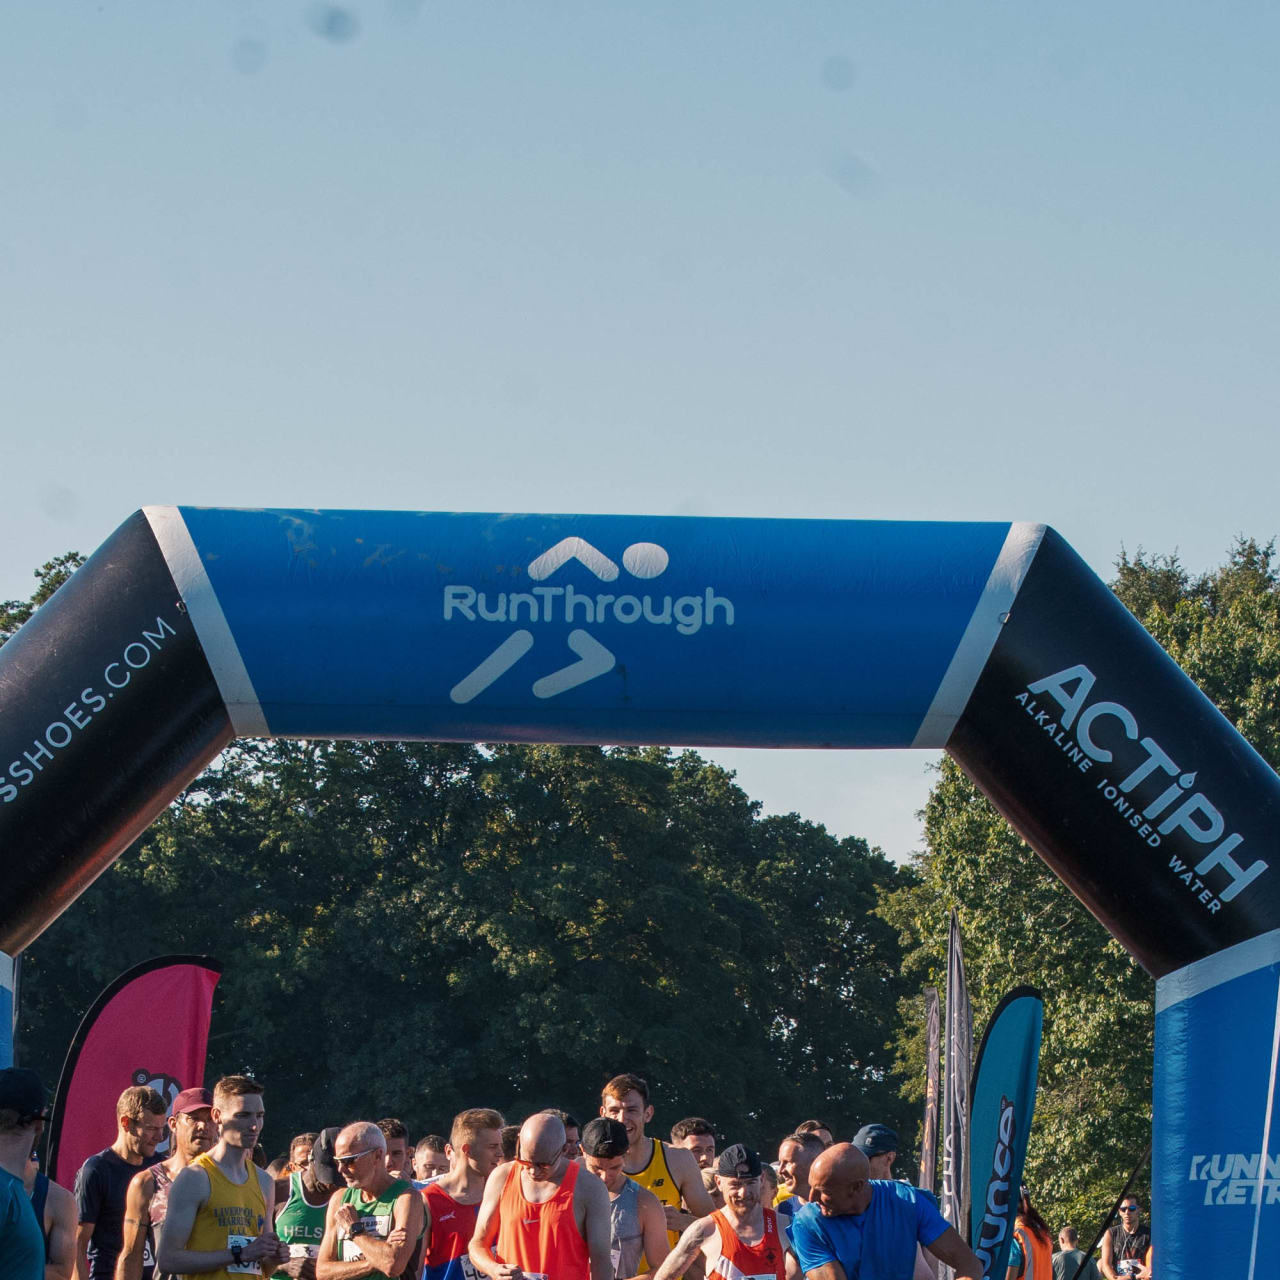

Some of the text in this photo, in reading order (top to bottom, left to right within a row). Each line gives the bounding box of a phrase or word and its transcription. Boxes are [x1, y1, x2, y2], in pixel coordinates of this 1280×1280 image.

[444, 584, 734, 635] RunThrough
[1015, 692, 1222, 915] ALKALINE IONISED WATER
[283, 1225, 323, 1239] HELS
